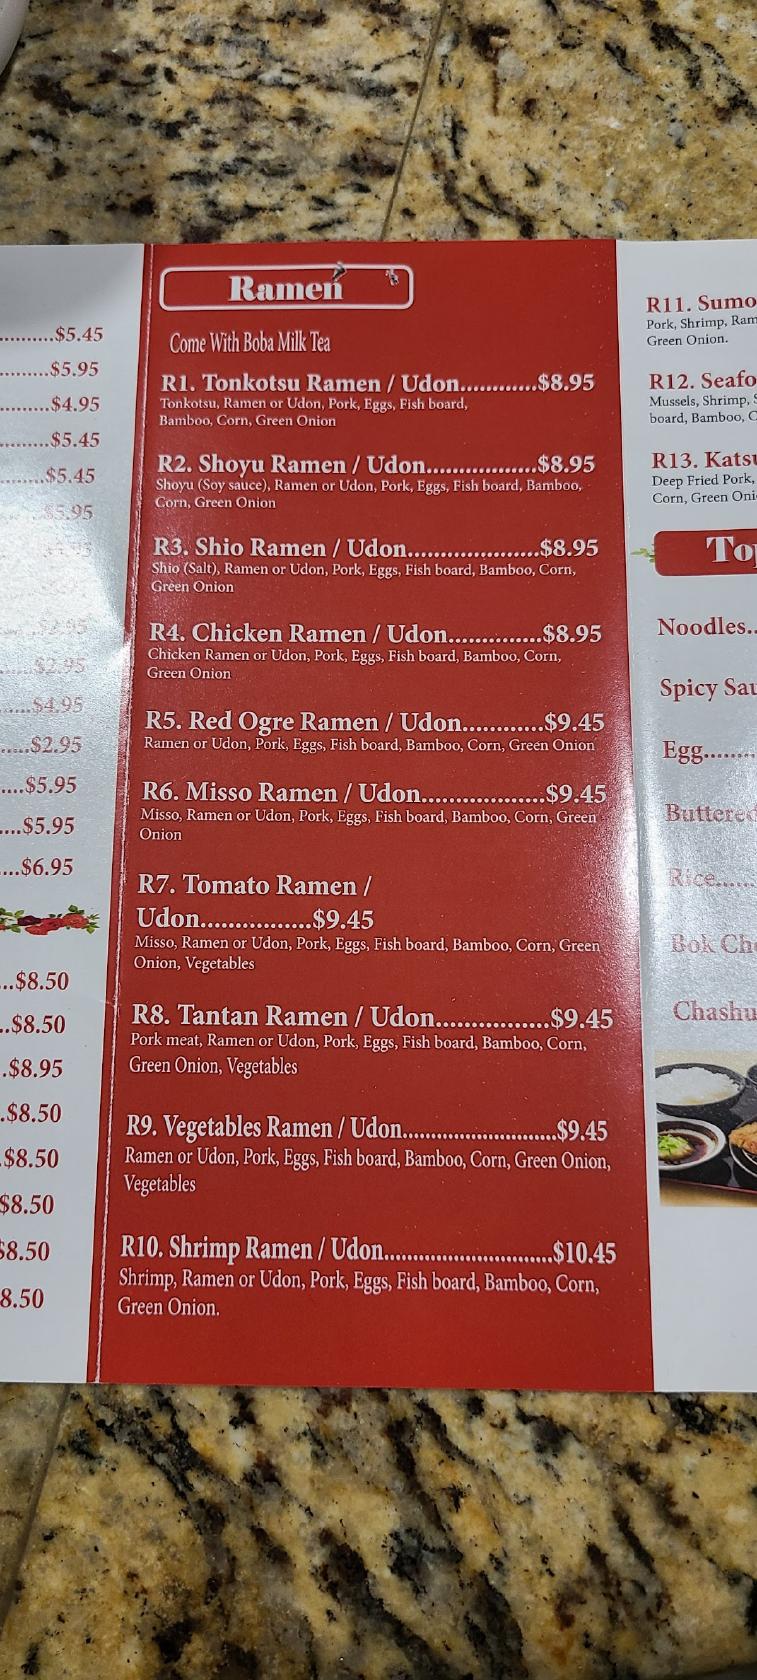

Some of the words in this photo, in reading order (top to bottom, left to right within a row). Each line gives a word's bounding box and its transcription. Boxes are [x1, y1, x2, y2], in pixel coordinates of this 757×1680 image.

[230, 273, 344, 301] Ramen
[646, 296, 692, 313] R11.
[698, 294, 757, 312] Sumo
[647, 318, 678, 330] Pork,
[680, 317, 728, 330] Shrimp,
[170, 333, 206, 353] Come
[210, 331, 239, 352] With
[244, 331, 274, 352] Boba
[278, 331, 306, 351] Milk
[310, 331, 330, 351] Tea
[647, 336, 683, 346] Green
[686, 334, 728, 346] Onion.
[162, 375, 194, 391] R1.
[202, 373, 300, 391] Tonkotsu
[307, 374, 380, 392] Ramen
[649, 374, 694, 390] R12.
[701, 370, 757, 389] Seafo
[160, 397, 219, 409] Tonkotsu,
[224, 398, 266, 408] Ramen
[287, 397, 324, 409] Udon,
[329, 398, 360, 410] Pork,
[365, 398, 395, 413] Eggs,
[400, 398, 424, 409] Fish
[429, 397, 467, 410] board,
[650, 395, 700, 408] Mussels,
[702, 395, 750, 409] Shrimp,
[160, 415, 212, 426] Bamboo,
[217, 415, 252, 426] Corn,
[256, 415, 292, 425] Green
[297, 415, 335, 426] Onion
[650, 412, 688, 426] board,
[691, 411, 745, 424] Bamboo,
[158, 455, 192, 472] R2.
[199, 454, 264, 478] Shoyu
[271, 455, 346, 473] Ramen
[652, 452, 698, 469] R13.
[156, 478, 193, 493] Shoyu
[198, 479, 225, 493] (Soy
[229, 479, 270, 492] sauce),
[275, 479, 317, 490] Ramen
[340, 479, 377, 492] Udon,
[382, 480, 413, 492] Pork,
[418, 480, 449, 495] Eggs,
[454, 479, 478, 491] Fish
[483, 479, 522, 491] board,
[527, 479, 581, 491] Bamboo,
[652, 475, 684, 489] Deep
[687, 474, 719, 486] Fried
[722, 472, 755, 486] Pork,
[155, 496, 190, 510] Corn,
[195, 497, 232, 507] Green
[236, 497, 275, 508] Onion
[652, 492, 688, 504] Corn,
[690, 492, 728, 504] Green
[154, 537, 188, 558] R3.
[196, 537, 243, 555] Shio
[250, 538, 326, 556] Ramen
[150, 623, 184, 641] R4.
[192, 623, 282, 642] Chicken
[289, 624, 366, 642] Ramen
[660, 678, 718, 701] Spicy
[145, 711, 181, 729] R5.
[189, 711, 232, 729] Red
[239, 712, 294, 736] Ogre
[300, 712, 378, 731] Ramen
[143, 782, 178, 800] R6.
[185, 782, 252, 801] Misso
[259, 783, 338, 802] Ramen
[138, 874, 174, 893] R7.
[183, 874, 269, 894] Tomato
[276, 875, 356, 895] Ramen
[135, 936, 177, 949] Misso,
[182, 936, 228, 948] Ramen
[252, 936, 292, 951] Udon,
[297, 937, 330, 951] Pork,
[336, 937, 369, 953] Eggs,
[375, 937, 401, 950] Fish
[406, 937, 448, 952] board,
[453, 938, 512, 952] Bamboo,
[516, 938, 556, 953] Corn,
[560, 937, 600, 953] Green
[134, 956, 180, 970] Onion,
[185, 956, 254, 973] Vegetables
[132, 1004, 169, 1024] R8.
[178, 1004, 258, 1025] Tantan
[266, 1005, 348, 1026] Ramen
[131, 1032, 162, 1045] Pork
[166, 1035, 202, 1047] meat,
[208, 1034, 254, 1046] Ramen
[278, 1034, 319, 1049] Udon,
[324, 1034, 358, 1049] Pork,
[363, 1035, 398, 1052] Eggs,
[403, 1035, 430, 1048] Fish
[435, 1035, 478, 1050] board,
[483, 1036, 543, 1051] Bamboo,
[547, 1037, 586, 1051] Corn,
[130, 1056, 170, 1072] Green
[175, 1057, 222, 1075] Onion,
[227, 1057, 297, 1079] Vegetables
[127, 1115, 156, 1135] R9.
[163, 1115, 261, 1143] Vegetables
[267, 1116, 332, 1137] Ramen
[121, 1235, 163, 1257] R10.
[170, 1235, 240, 1265] Shrimp
[246, 1237, 312, 1259] Ramen
[120, 1267, 176, 1291] Shrimp,
[182, 1269, 234, 1287] Ramen
[260, 1270, 305, 1290] Udon,
[311, 1270, 348, 1290] Pork,
[354, 1272, 392, 1294] Eggs,
[397, 1272, 427, 1289] Fish
[432, 1272, 480, 1292] board,
[485, 1273, 551, 1294] Bamboo,
[556, 1274, 599, 1294] Corn,
[118, 1297, 162, 1315] Green
[168, 1298, 219, 1315] Onion.
